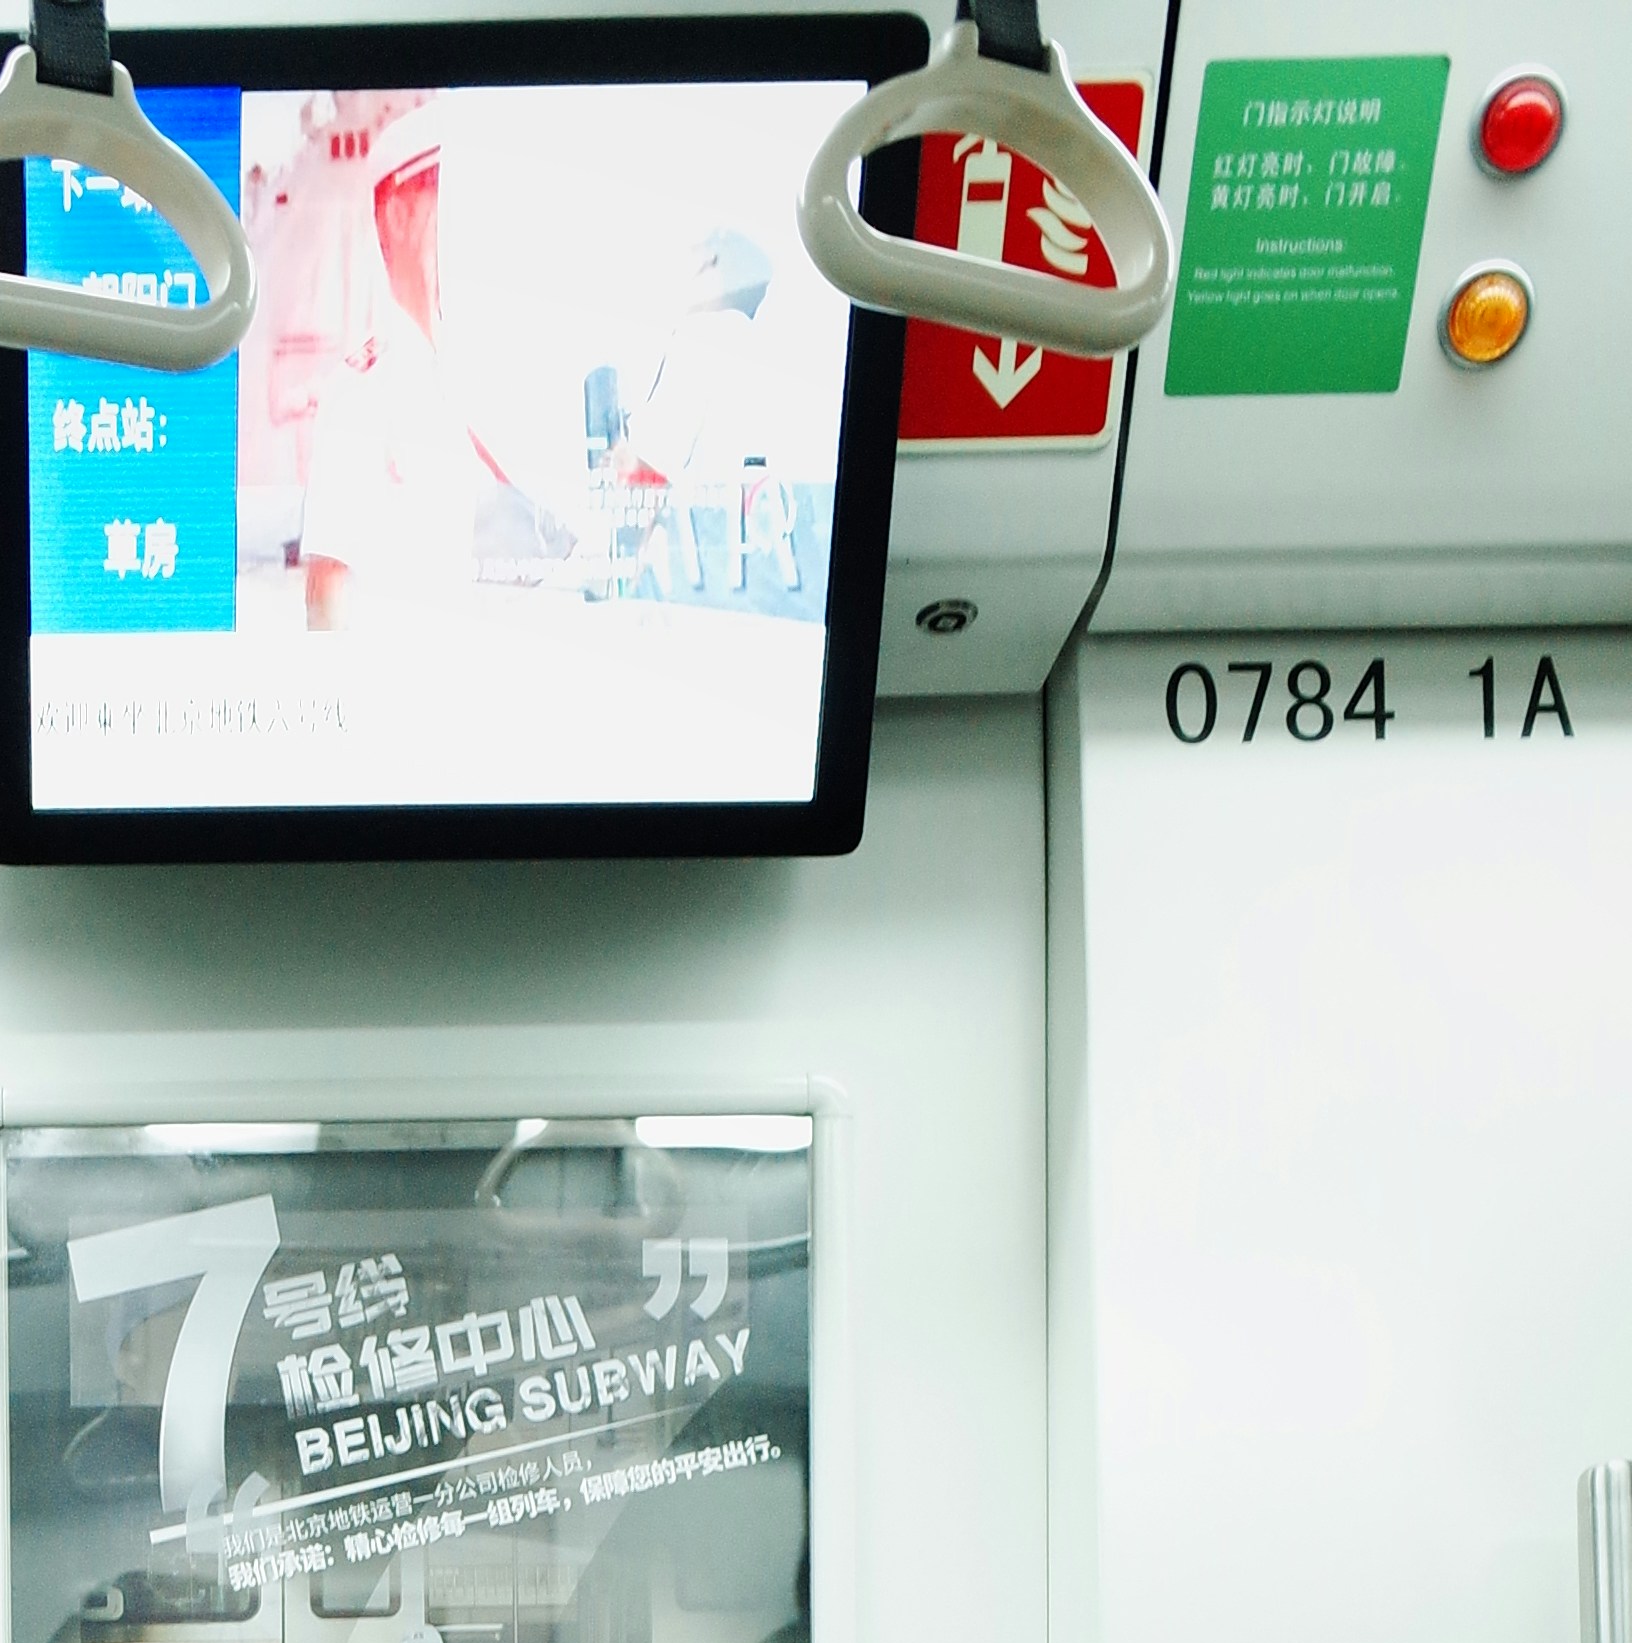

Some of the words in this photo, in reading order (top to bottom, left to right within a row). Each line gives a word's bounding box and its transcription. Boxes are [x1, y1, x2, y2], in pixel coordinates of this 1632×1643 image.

[1242, 97, 1382, 128] 门指示灯说明
[103, 517, 180, 581] 草房
[1165, 656, 1396, 744] 0784
[1468, 654, 1576, 740] 1A
[261, 1252, 412, 1343] 号线
[67, 1194, 281, 1518] 7
[276, 1294, 597, 1420] 检修中心
[295, 1386, 508, 1476] BEIJING
[520, 1327, 751, 1423] SUBWAY
